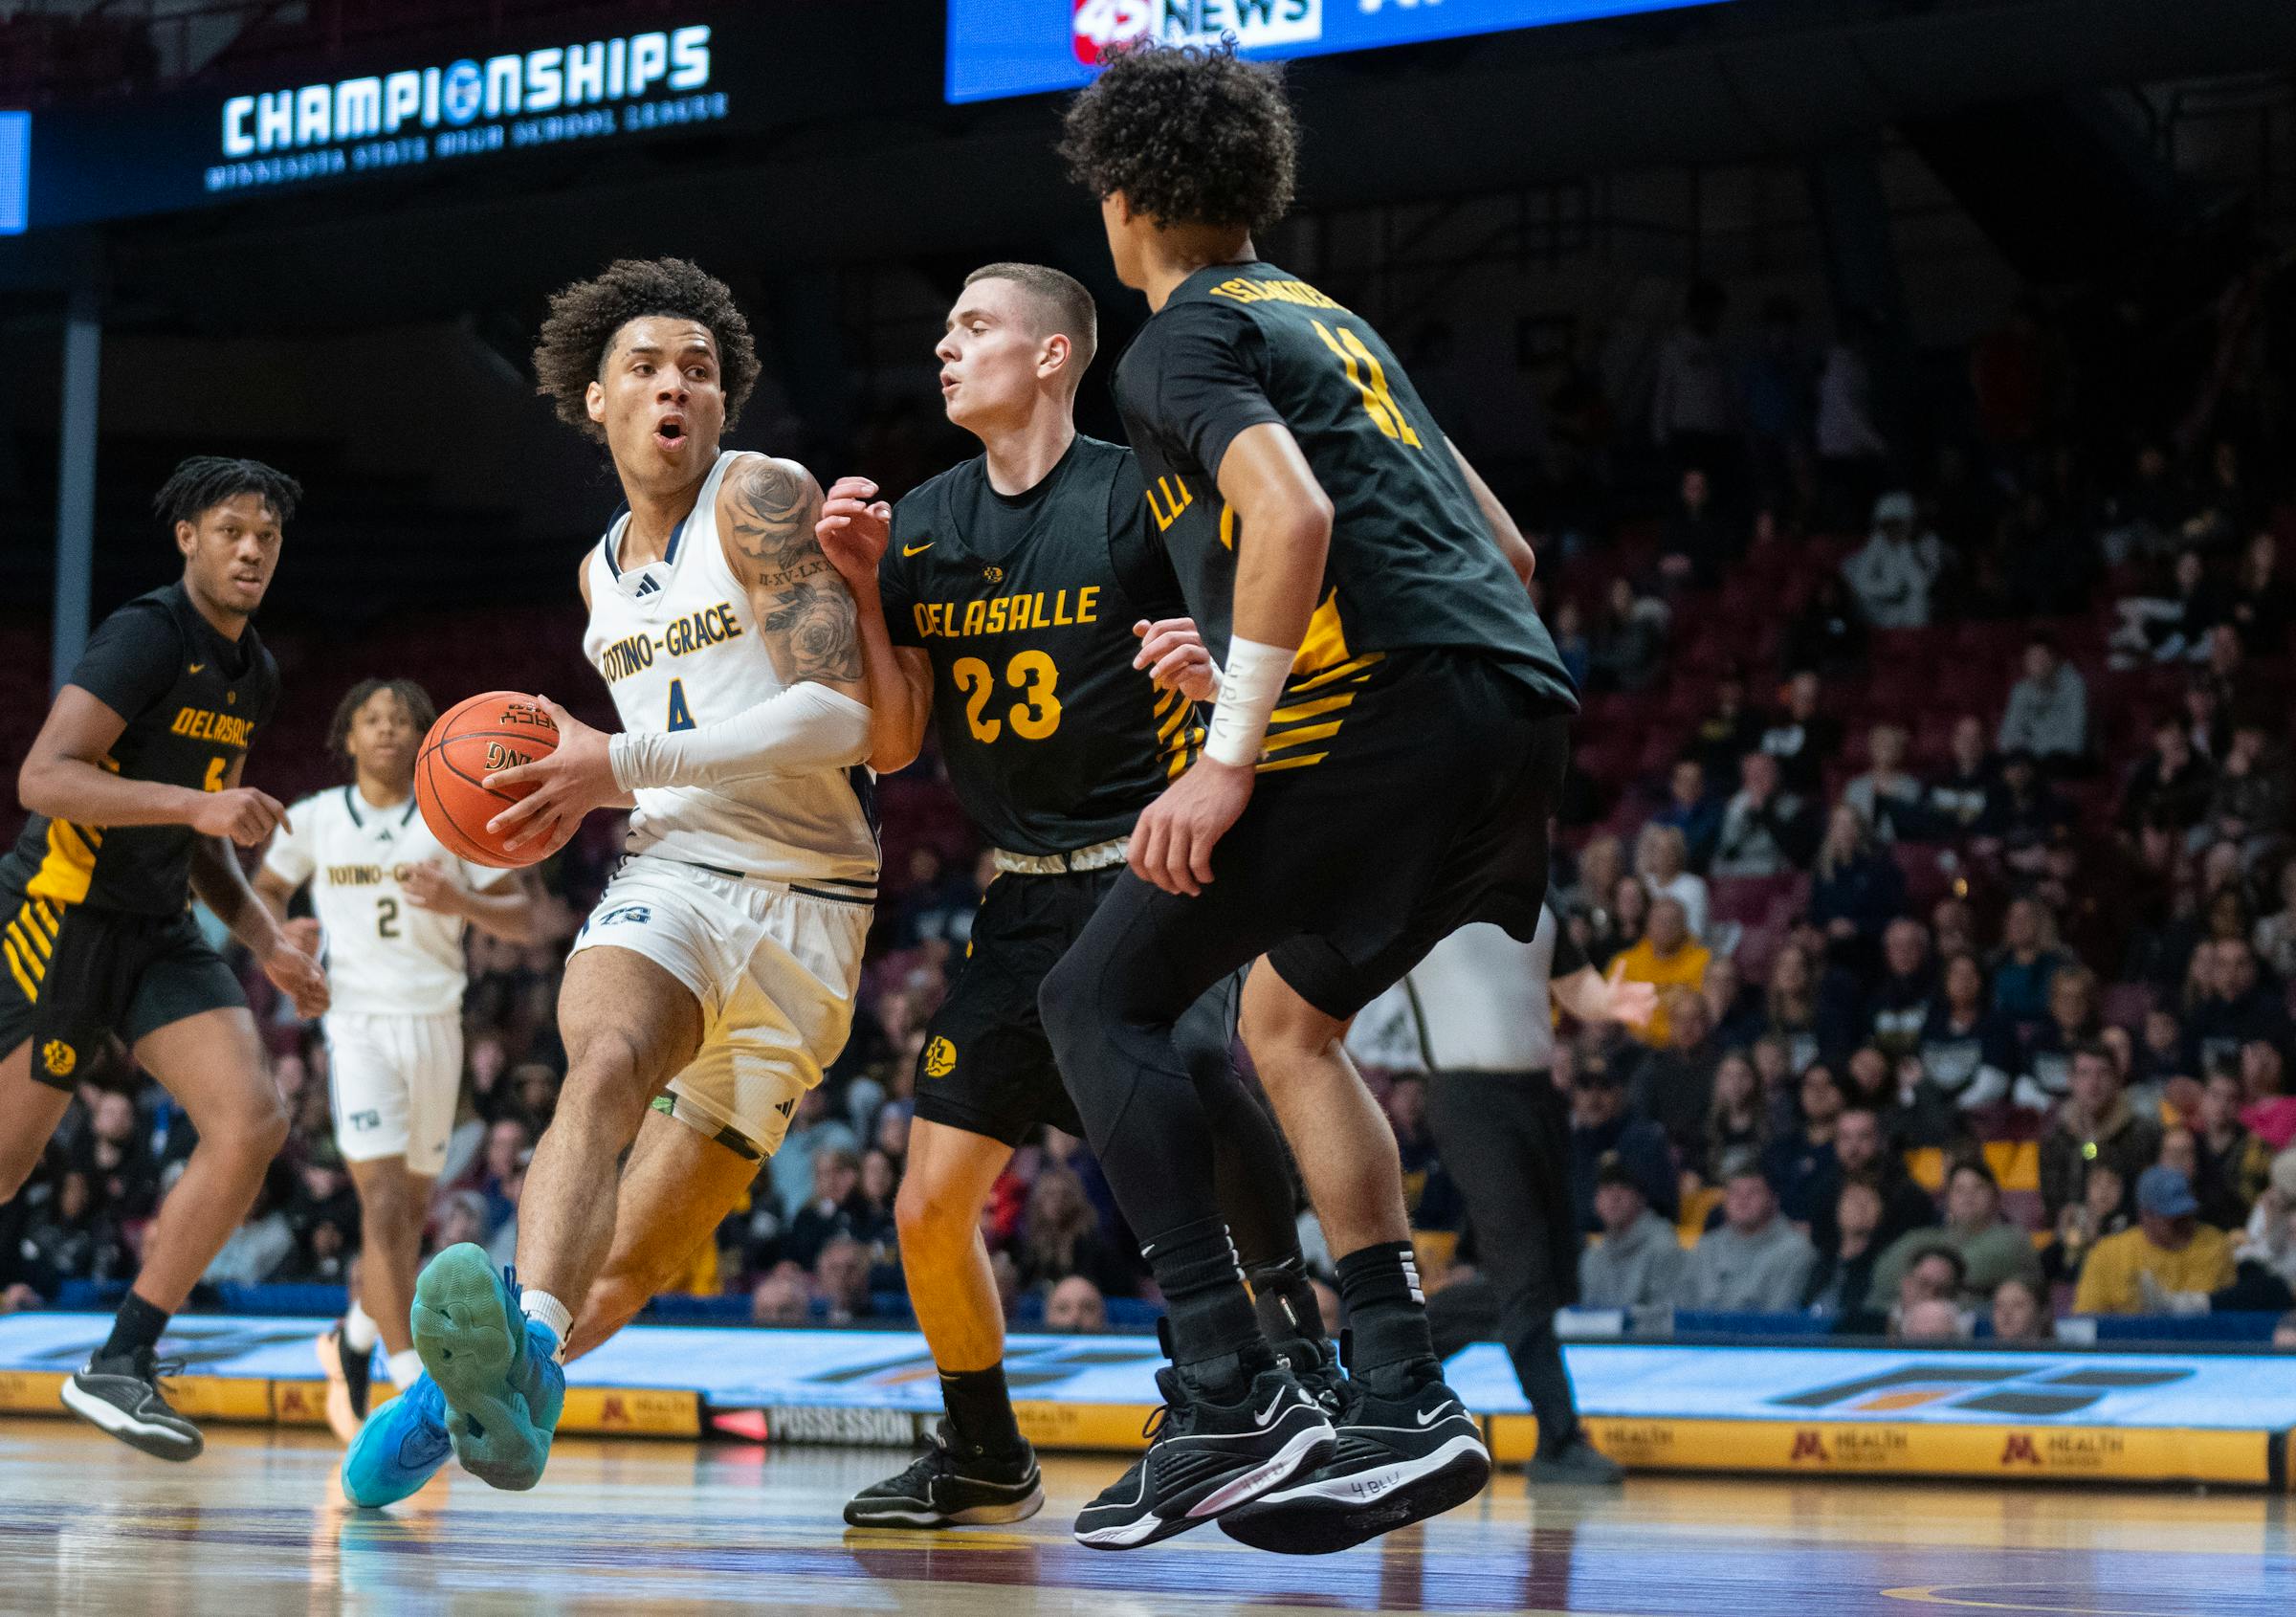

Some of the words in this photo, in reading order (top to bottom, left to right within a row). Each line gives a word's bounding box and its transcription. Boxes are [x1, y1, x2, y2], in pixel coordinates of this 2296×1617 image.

[1163, 0, 1309, 35] NEWS
[1312, 320, 1423, 450] 11
[913, 586, 1100, 639] DELASALLE
[602, 602, 743, 687] TOTINO-GRACE
[667, 676, 697, 733] 4
[953, 650, 1063, 743] 23
[375, 897, 400, 939] 2
[771, 1407, 915, 1444] POSSESSION
[1351, 1482, 1366, 1498] 4
